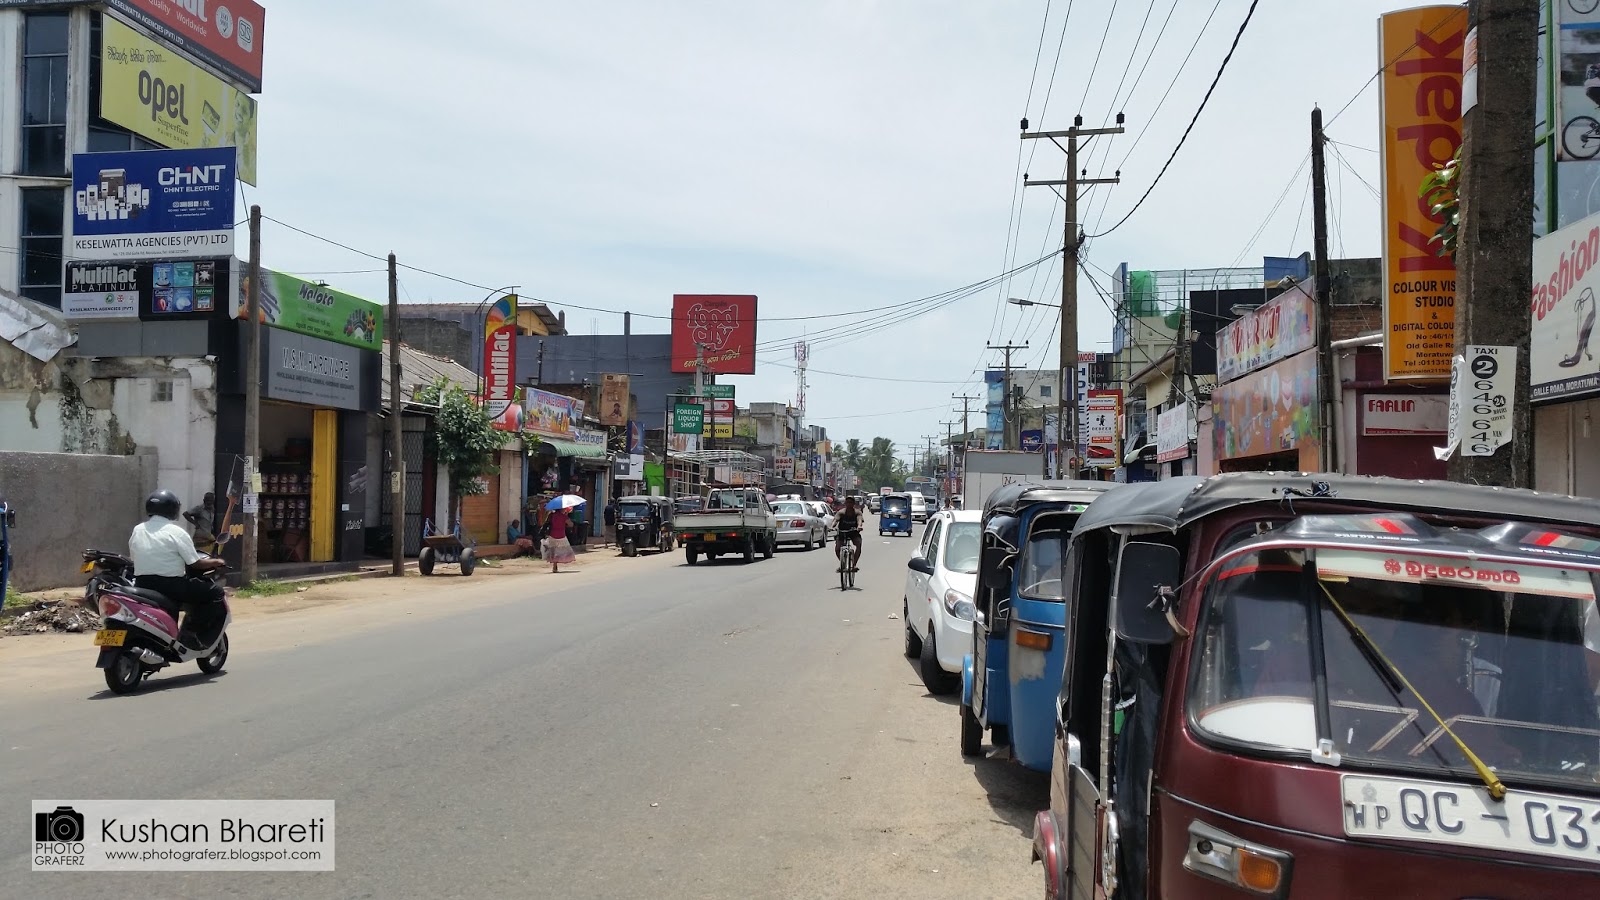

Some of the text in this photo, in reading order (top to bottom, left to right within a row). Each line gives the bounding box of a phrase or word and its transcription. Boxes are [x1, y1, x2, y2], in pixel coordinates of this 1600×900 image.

[111, 0, 141, 19] KESELWATTA
[142, 15, 163, 32] AGENCIES
[175, 35, 184, 44] LTD
[176, 11, 207, 37] Worldwide
[157, 116, 189, 137] Superfine
[75, 234, 229, 250] KESELWATTA AGENCIES (PVT) LTD
[72, 266, 137, 284] Multilac
[72, 283, 137, 293] PLATINUM
[1393, 280, 1456, 294] COLOUR VIS
[1415, 296, 1454, 308] STUDIO
[1431, 311, 1438, 320] &
[1393, 322, 1454, 332] DIGITAL COLOU
[1474, 347, 1498, 355] TAXI
[308, 353, 349, 380] HARDWARE
[490, 331, 511, 400] Multilac
[1533, 377, 1598, 397] GALLE ROAD, MORATUWA
[1494, 396, 1505, 406] 24
[1352, 804, 1389, 829] WP
[1399, 787, 1464, 834] QC
